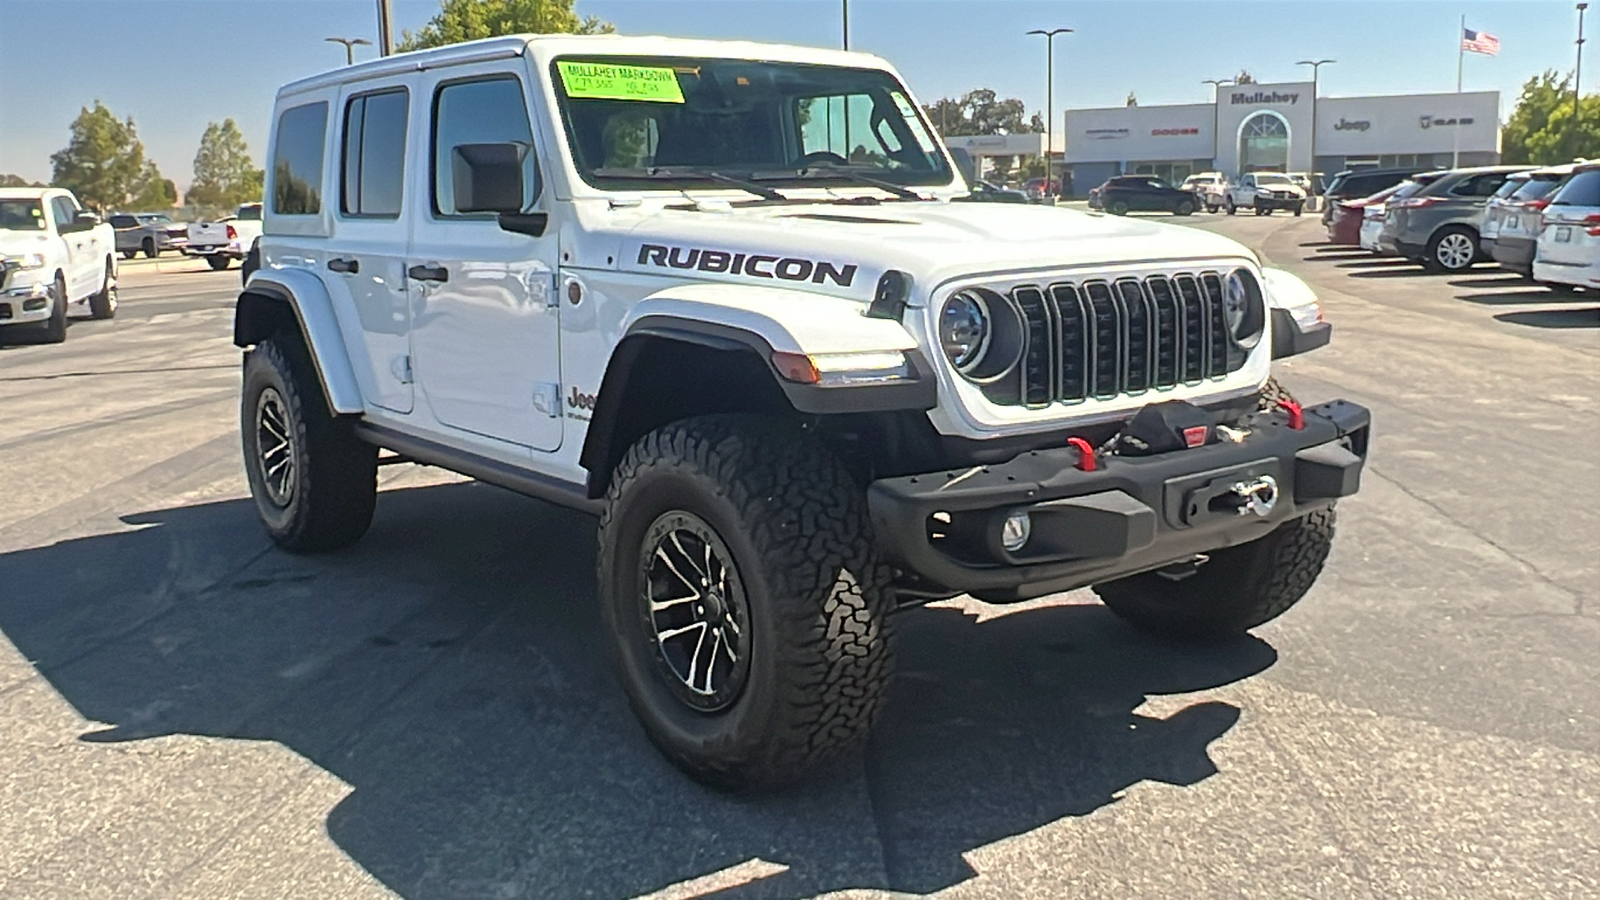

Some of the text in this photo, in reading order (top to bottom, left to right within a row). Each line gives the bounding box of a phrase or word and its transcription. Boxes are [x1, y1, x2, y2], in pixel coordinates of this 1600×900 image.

[1231, 91, 1299, 105] Mullahey
[1334, 117, 1371, 132] Jeep
[1434, 117, 1474, 126] RAM
[1151, 127, 1199, 136] DODGE
[637, 244, 858, 287] RUBICON
[567, 386, 598, 411] Jee
